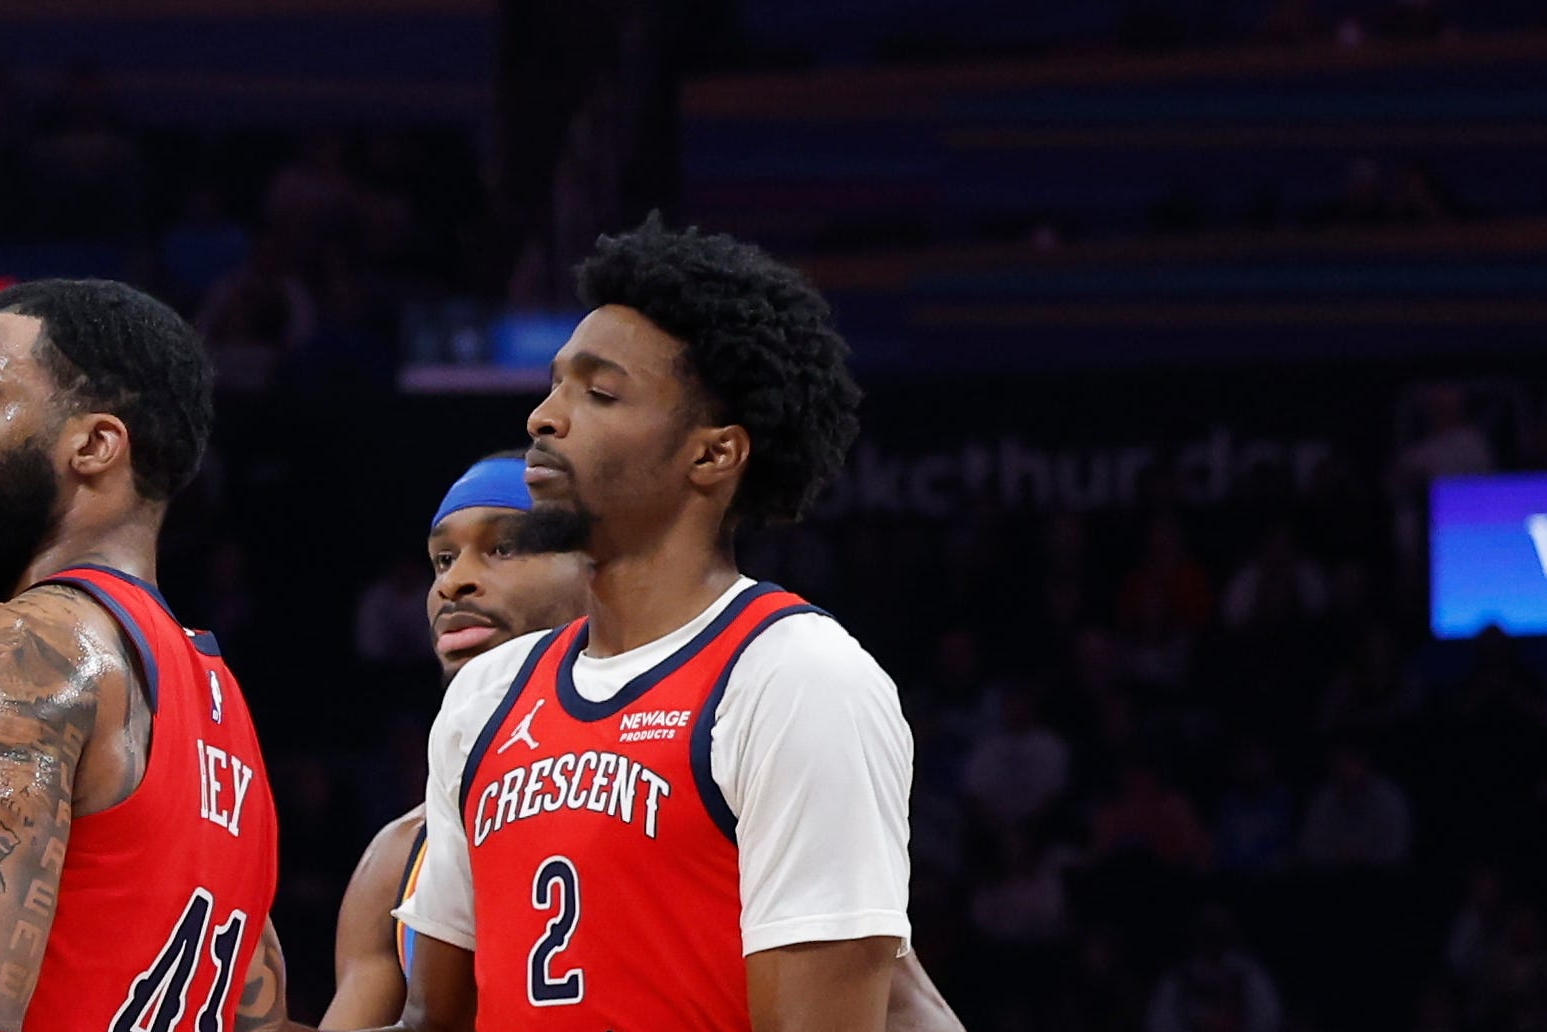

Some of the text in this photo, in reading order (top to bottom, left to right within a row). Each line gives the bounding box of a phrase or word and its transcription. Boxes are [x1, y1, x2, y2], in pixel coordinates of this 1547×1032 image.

[618, 728, 676, 742] PRODUCTS
[619, 710, 692, 731] NEWAGE
[472, 750, 671, 848] CRESCENT
[526, 854, 585, 1008] 2
